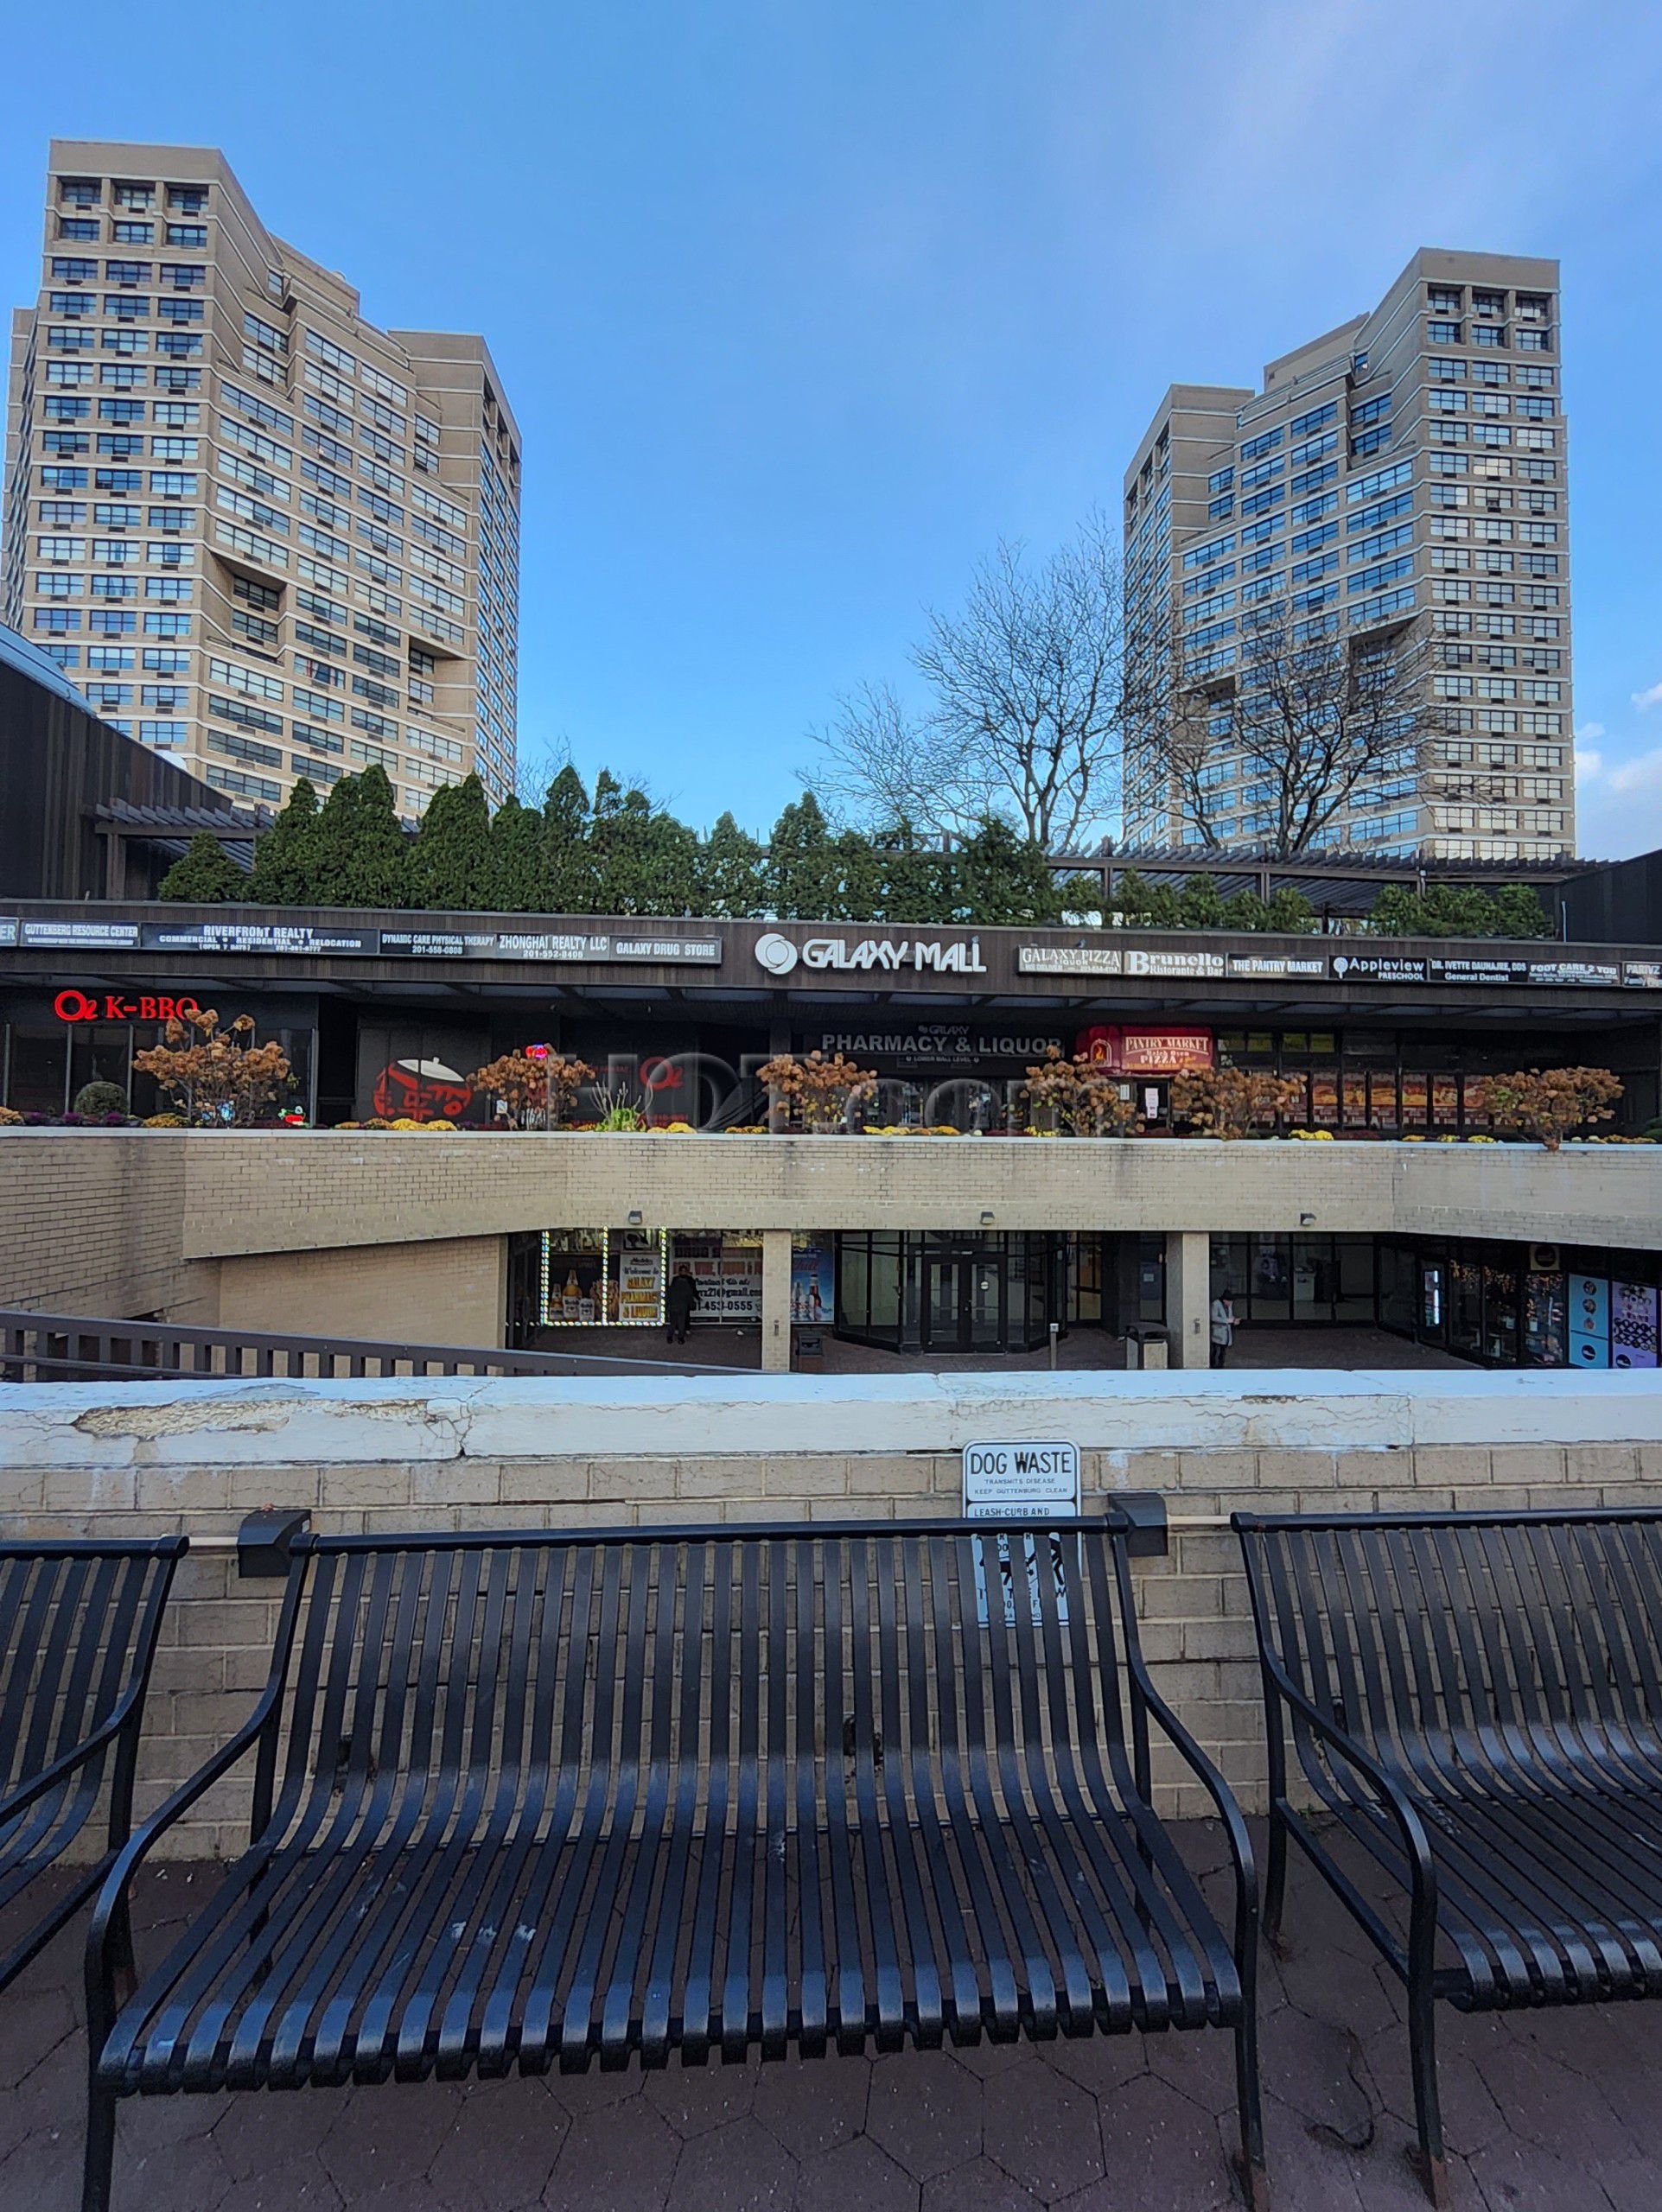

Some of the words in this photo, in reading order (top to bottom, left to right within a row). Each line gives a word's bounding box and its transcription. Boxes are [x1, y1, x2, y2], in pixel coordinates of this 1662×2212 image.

[24, 924, 71, 936] GUTTENBERG
[72, 925, 109, 937] RESOURCE
[110, 925, 138, 938] CENTER
[203, 925, 271, 938] RIVERFRONT
[273, 927, 314, 939] REALTY
[159, 935, 218, 944] COMMERCIAL
[236, 937, 292, 945] RESIDENTIAL
[309, 938, 362, 948] RELOCATION
[382, 933, 411, 944] DYNAMIC
[413, 934, 431, 944] CARE
[432, 935, 463, 945] PHYSICAL
[464, 936, 494, 947] THERAPY
[499, 935, 549, 949] ZHONGHAI
[552, 936, 587, 950] REALTY
[589, 937, 608, 950] LLC
[616, 942, 653, 955] GALAXY
[653, 943, 680, 956] DRUG
[685, 944, 716, 957] STORE
[802, 938, 908, 970] GALAXY
[914, 942, 988, 972] MALL
[1022, 948, 1078, 963] GALAXY
[1081, 950, 1121, 968] PIZZA
[1126, 950, 1225, 976] Brunello
[1349, 957, 1424, 972] Appleview
[1445, 961, 1470, 969] IVETTE
[1149, 966, 1195, 976] Ristorante
[1196, 967, 1205, 976] &
[1207, 967, 1225, 977] Bar
[1232, 959, 1250, 972] THE
[1251, 960, 1286, 973] PANTRY
[1288, 961, 1323, 973] MARKET
[1596, 966, 1617, 975] YOU
[1379, 972, 1424, 981] PRESCHOOL
[1445, 972, 1478, 981] General
[1479, 973, 1509, 982] Dentist
[928, 1025, 970, 1035] GALAXY
[822, 1034, 946, 1052] PHARMACY
[955, 1037, 971, 1052] &
[1125, 1037, 1163, 1053] PANTRY
[1165, 1037, 1209, 1053] MARKET
[1140, 1055, 1177, 1065] PIZZA
[971, 1452, 1008, 1475] DOG
[1015, 1451, 1073, 1474] WASTE
[1031, 1507, 1050, 1516] AND
